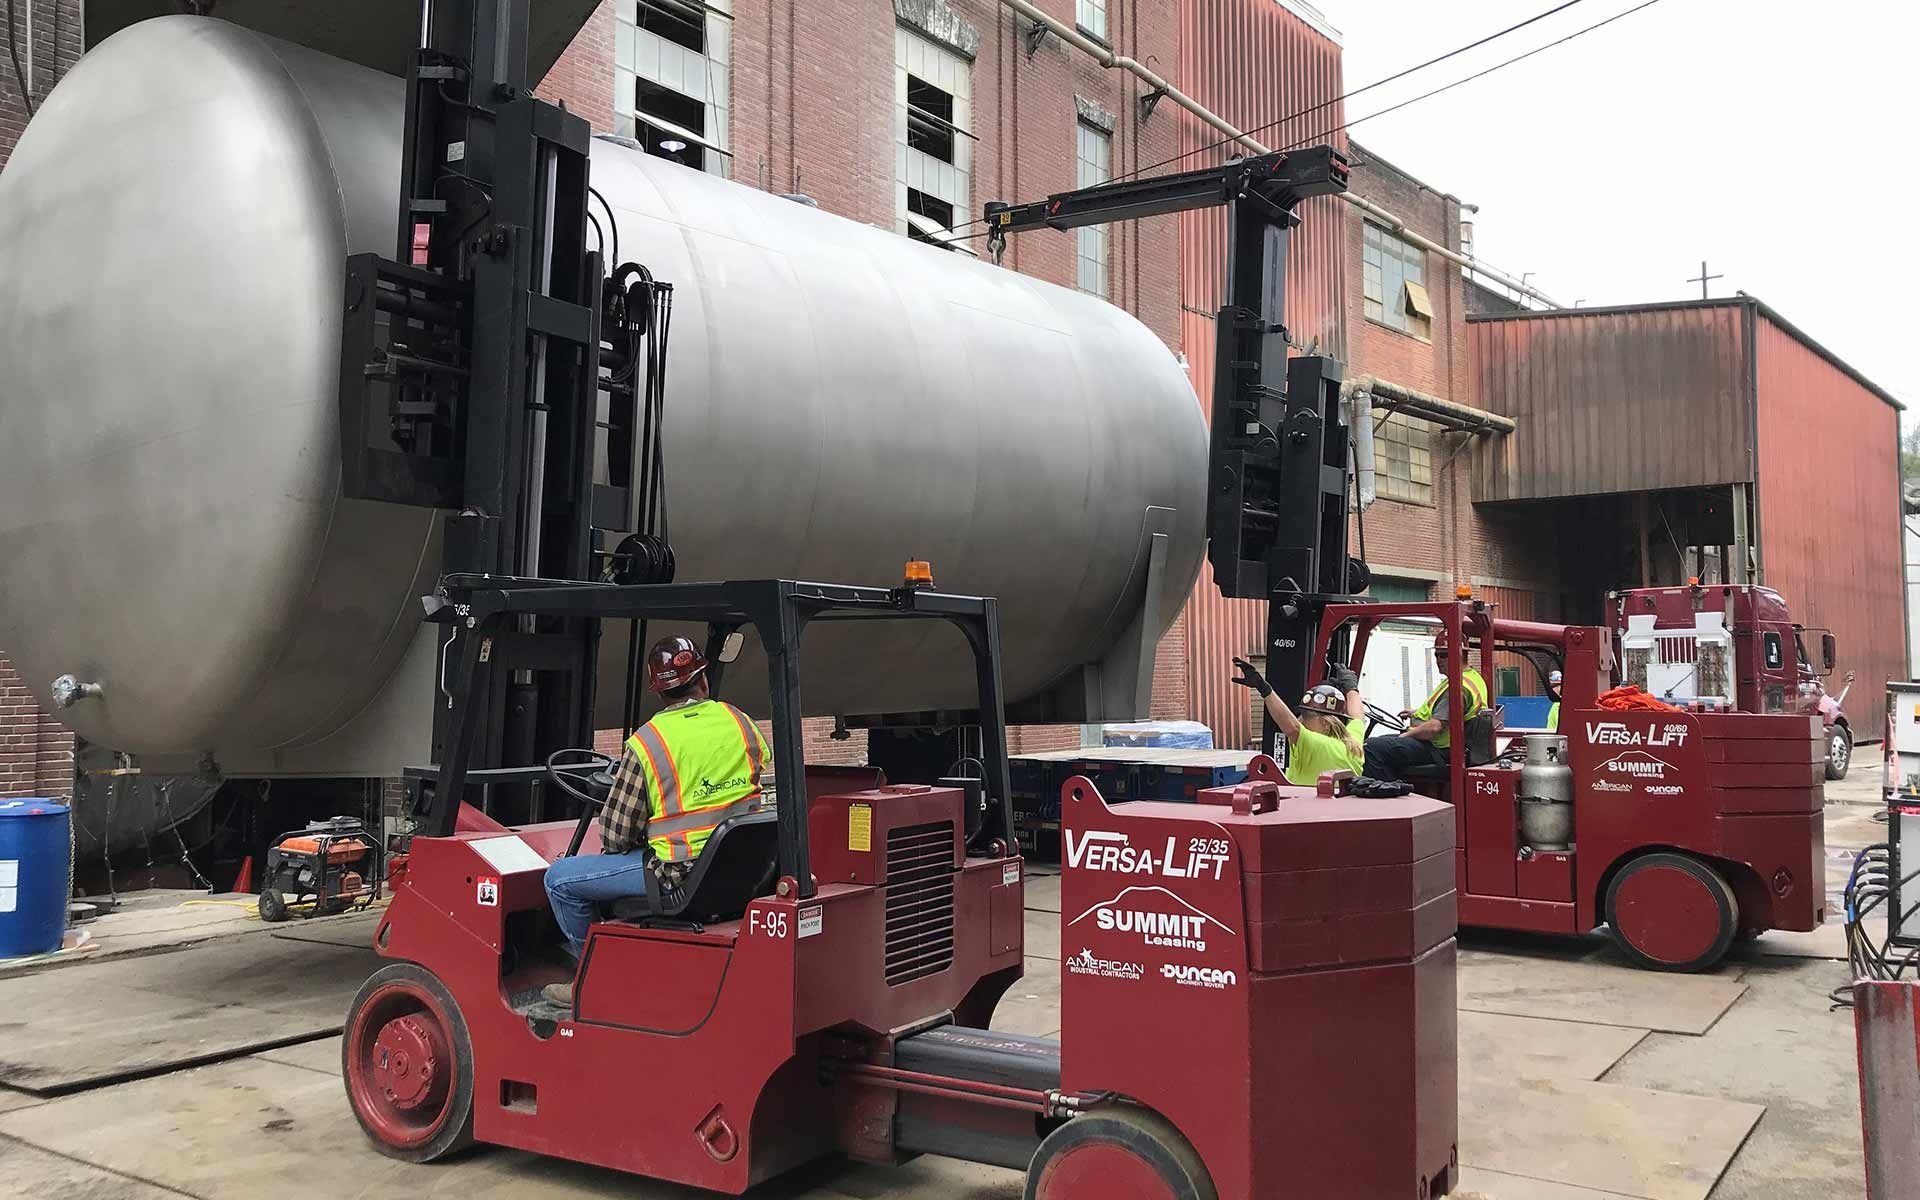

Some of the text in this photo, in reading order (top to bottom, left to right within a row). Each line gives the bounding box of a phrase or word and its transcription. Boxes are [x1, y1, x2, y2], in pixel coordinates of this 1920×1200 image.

[1274, 638, 1295, 648] 40/60
[1664, 724, 1688, 733] 40/60
[1608, 761, 1665, 773] SUMMIT
[1633, 771, 1664, 779] Leasing
[693, 777, 747, 798] AMERICAN
[1476, 781, 1500, 795] F-94
[1645, 785, 1684, 793] DUNCAN
[1188, 838, 1229, 854] 25/35
[750, 909, 787, 938] F-95
[1097, 908, 1206, 938] SUMMIT
[1145, 933, 1206, 952] Leasing
[1066, 956, 1144, 974] AMERICAN
[1070, 966, 1140, 980] INDUSTRIAL CONTRACTORS
[1163, 964, 1236, 985] DUNCAN
[560, 1028, 573, 1037] GAS
